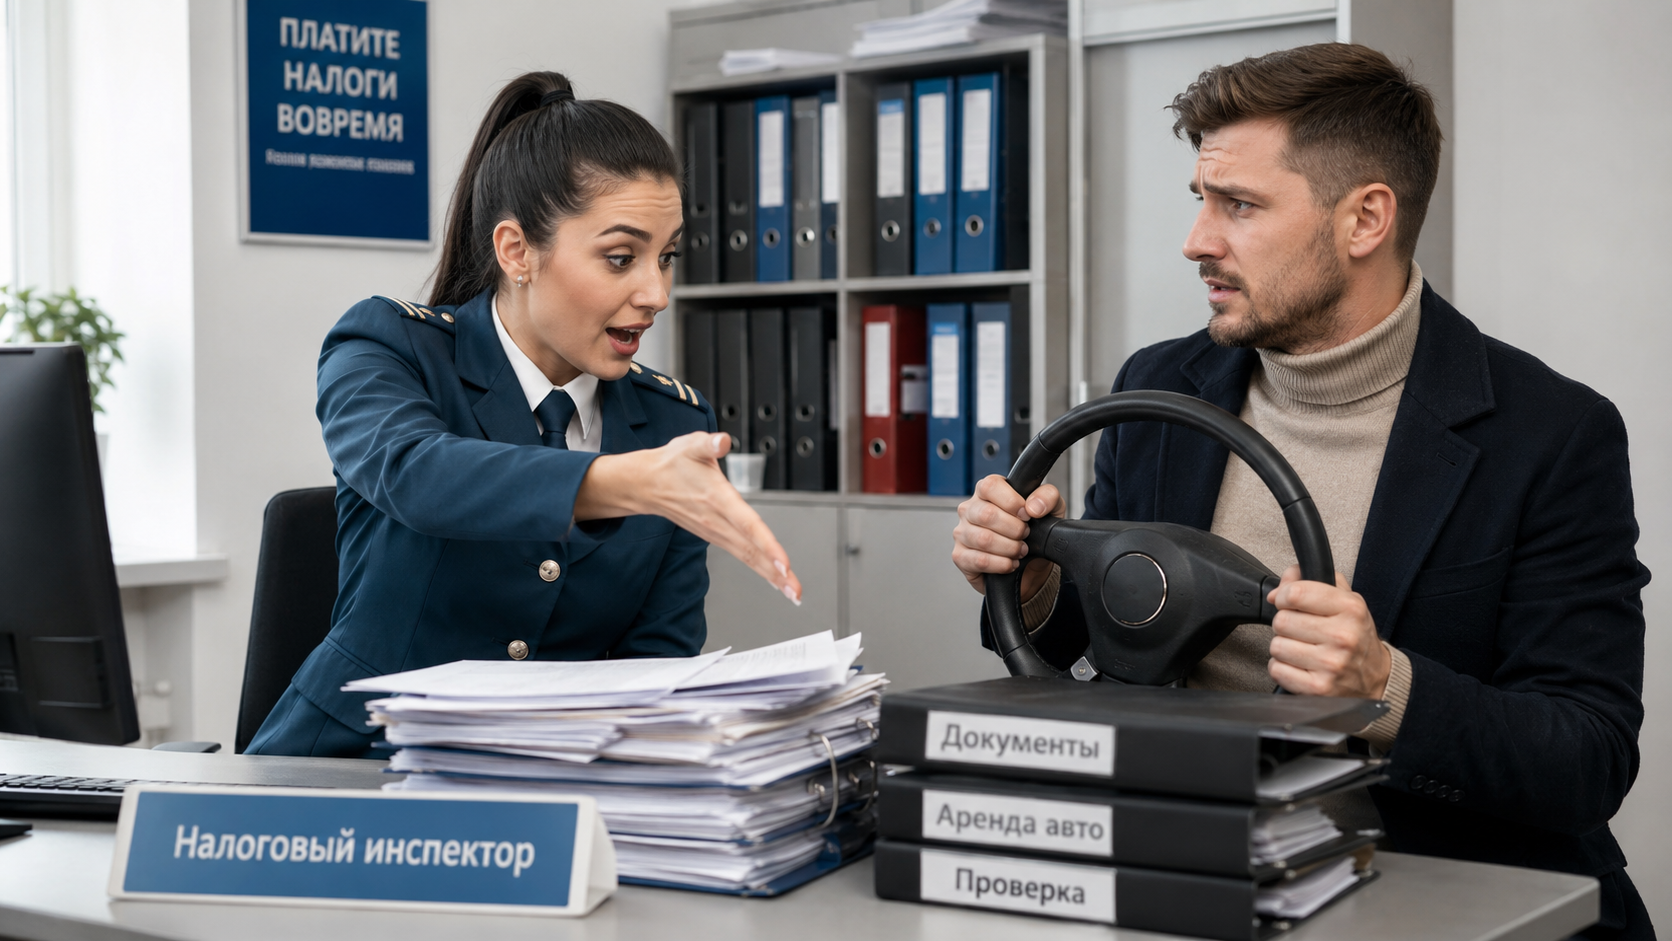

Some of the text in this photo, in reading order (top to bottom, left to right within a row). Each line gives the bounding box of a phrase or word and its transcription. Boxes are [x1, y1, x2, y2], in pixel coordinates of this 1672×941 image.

[280, 17, 401, 59] ПЛАТИТЕ
[284, 60, 398, 101] НАЛОГИ
[277, 104, 404, 142] ВОВРЕМЯ
[941, 724, 1099, 759] Документы
[937, 803, 1105, 841] Аренда авто
[173, 824, 535, 877] Налоговый инспектор
[955, 868, 1086, 906] Проверка
